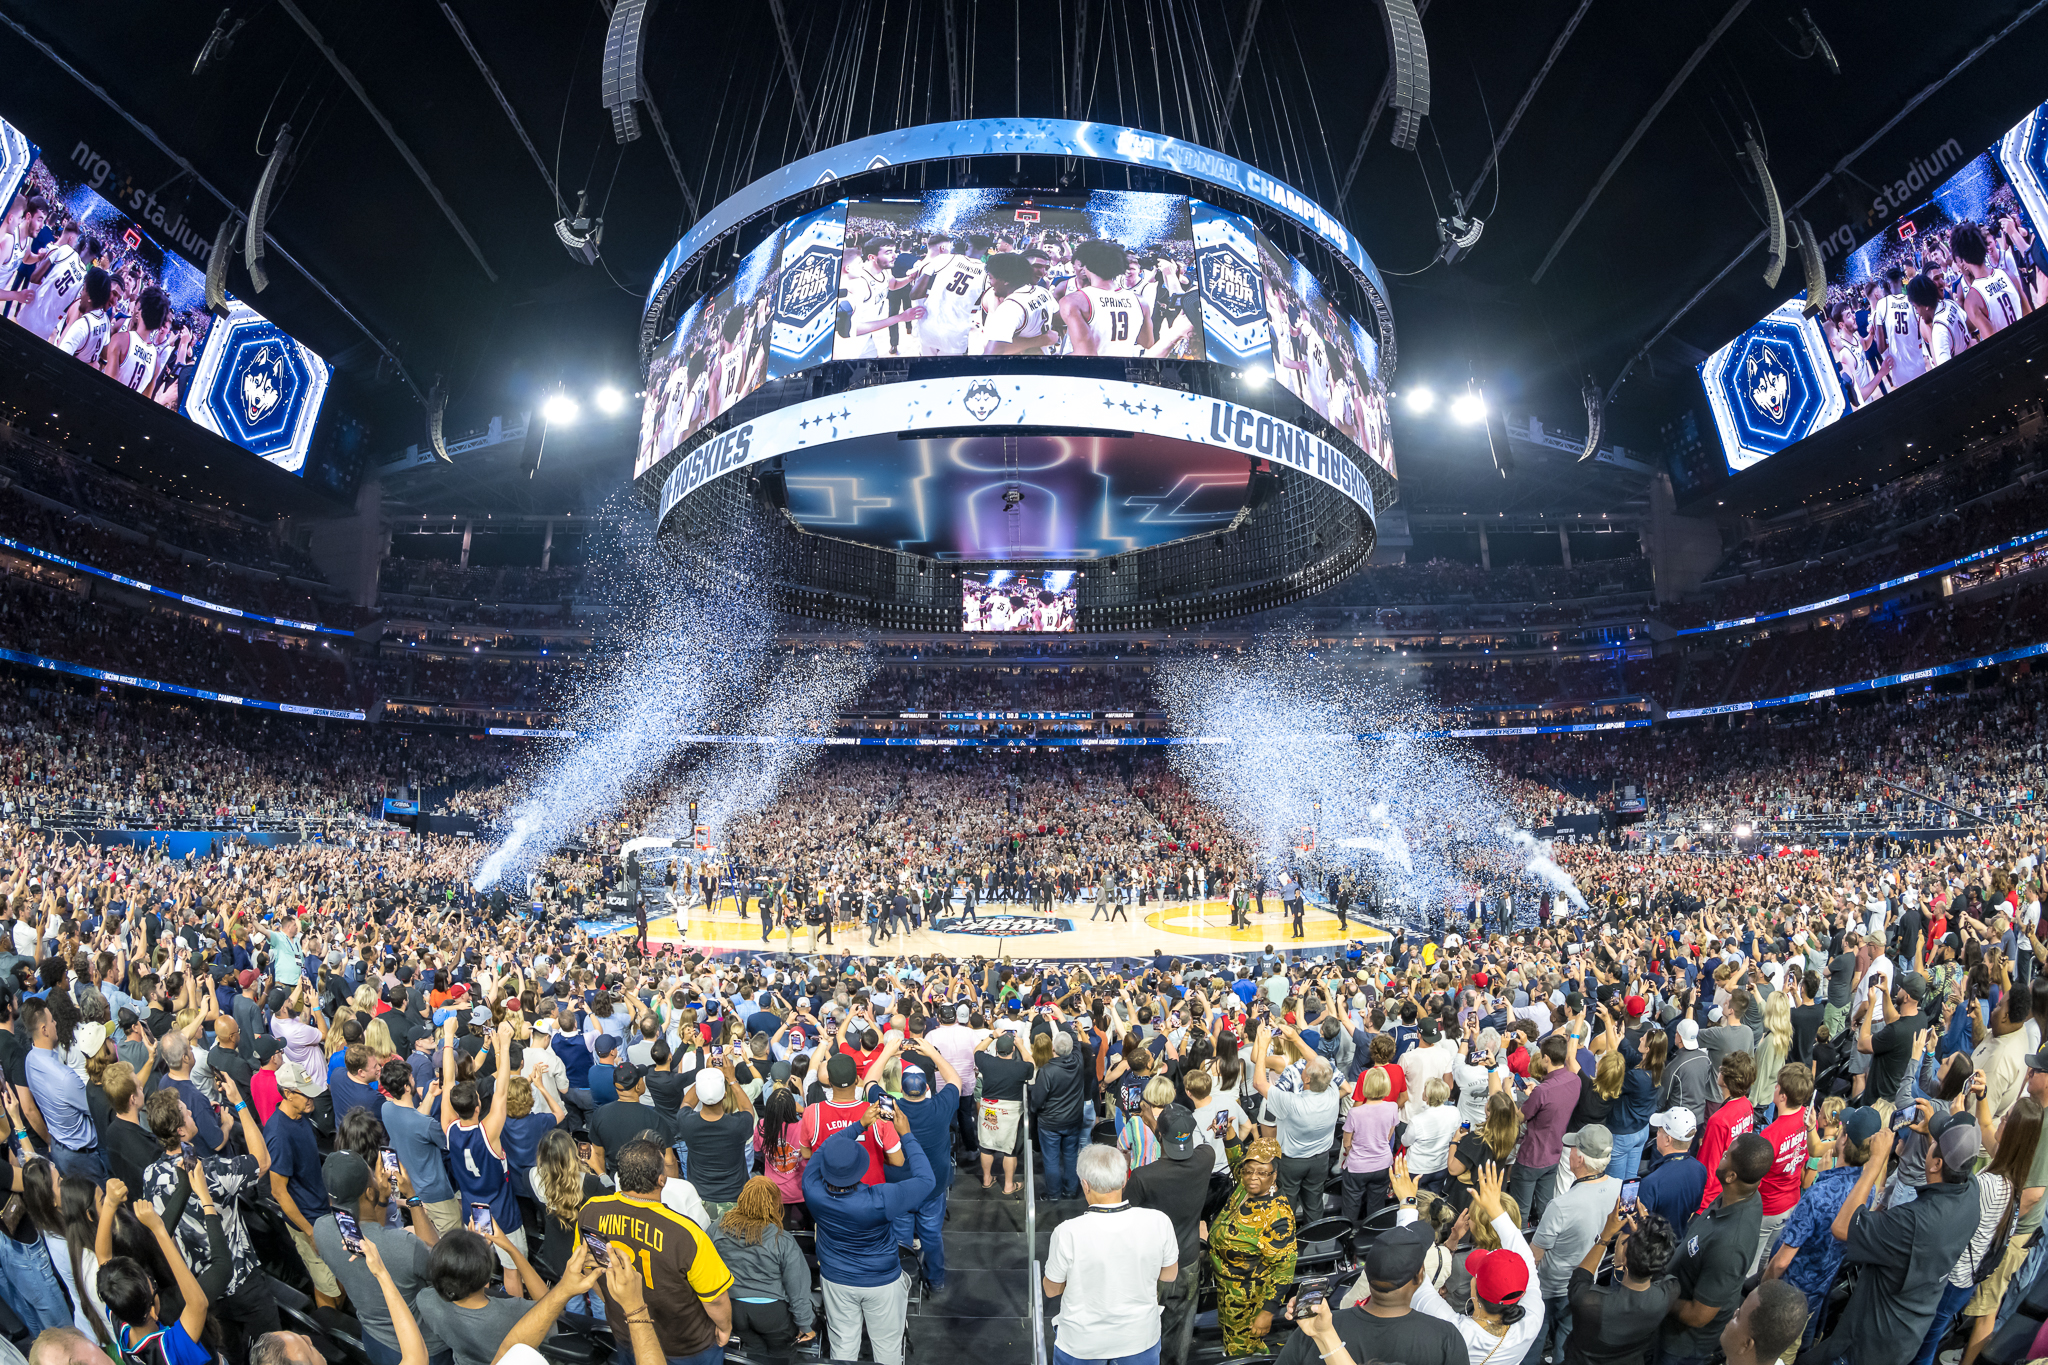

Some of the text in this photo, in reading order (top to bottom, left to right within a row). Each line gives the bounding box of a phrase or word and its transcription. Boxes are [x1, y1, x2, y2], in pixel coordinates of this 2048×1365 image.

[70, 140, 111, 189] nrg
[1873, 138, 1963, 219] stadium
[1247, 169, 1348, 250] CHAMPIONS
[54, 269, 75, 297] 35
[790, 261, 830, 290] FINAL
[946, 270, 974, 296] 35
[1211, 262, 1250, 288] FINAL
[791, 277, 829, 303] FOUR
[1099, 297, 1132, 308] SPRINGS
[1217, 278, 1254, 301] FOUR
[1894, 311, 1909, 335] 35
[1996, 292, 2018, 326] 13
[1110, 311, 1128, 341] 13
[128, 361, 146, 391] 13
[725, 365, 737, 399] 13
[671, 424, 754, 502] HUSKIES
[1210, 402, 1373, 516] UCONN HUSKIES
[218, 693, 243, 705] CHAMPIONS
[1809, 688, 1836, 700] CHAMPIONS
[1596, 721, 1626, 731] CHAMPIONS
[826, 1120, 852, 1131] LEONA
[1731, 1122, 1743, 1138] SAN
[1779, 1139, 1791, 1154] SAN
[464, 1148, 481, 1177] 4
[598, 1214, 664, 1252] WINFIELD
